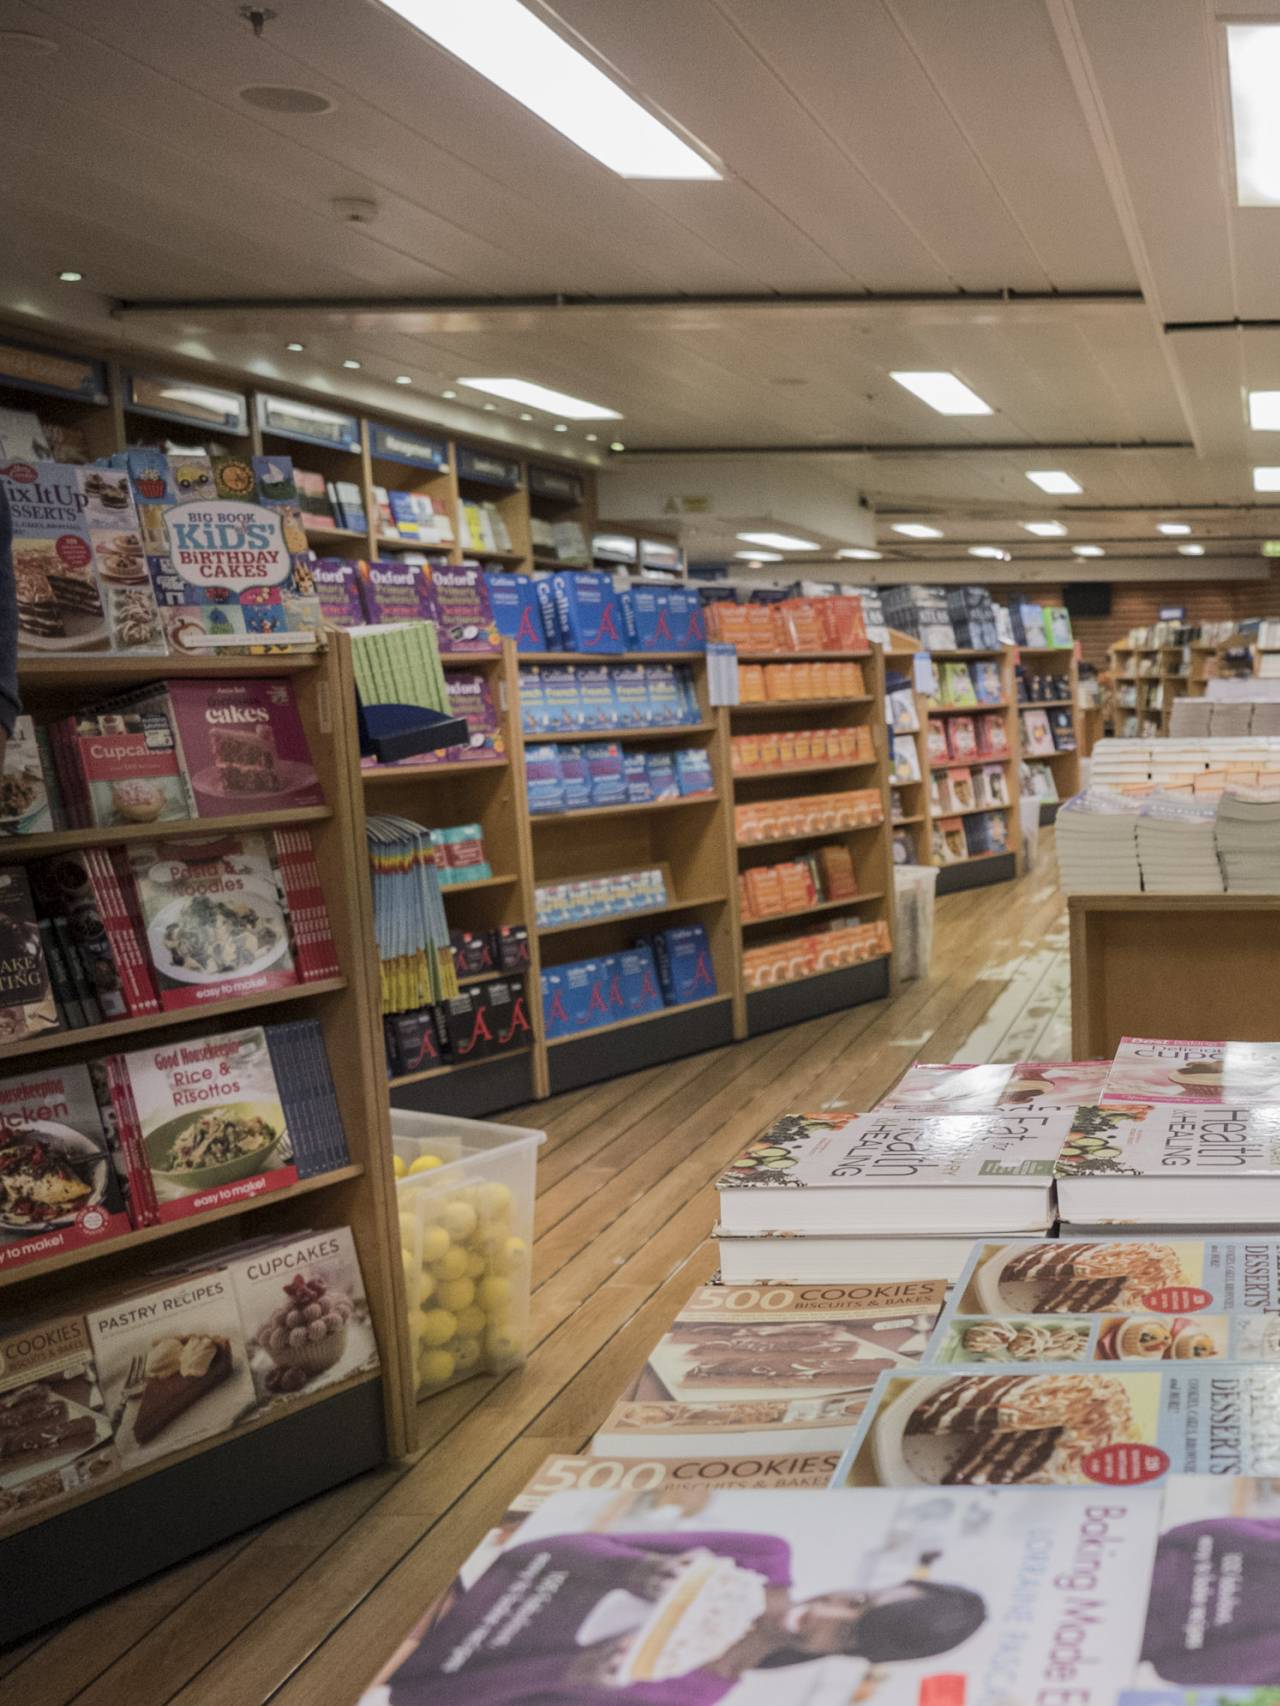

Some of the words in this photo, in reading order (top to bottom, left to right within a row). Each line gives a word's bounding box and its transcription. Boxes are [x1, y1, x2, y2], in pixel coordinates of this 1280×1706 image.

[57, 486, 89, 513] Up
[12, 506, 77, 523] SSERTS
[217, 512, 256, 523] BOOK
[200, 565, 269, 579] CAKES
[369, 570, 415, 586] Oxford
[432, 570, 476, 586] Oxford
[205, 705, 270, 724] cakes
[170, 863, 220, 882] Pasta
[223, 862, 238, 875] &
[172, 877, 244, 896] Noodles
[196, 986, 221, 1000] easy
[221, 982, 233, 995] to
[233, 975, 268, 993] make!
[155, 1051, 180, 1071] Good
[181, 1039, 242, 1064] Housekeeping
[173, 1068, 213, 1087] Rice
[218, 1061, 232, 1077] &
[173, 1080, 240, 1107] Risottos
[831, 1123, 897, 1177] HEALING
[1161, 1115, 1197, 1167] HEALING
[1198, 1109, 1264, 1167] Health
[194, 1191, 217, 1208] easy
[219, 1187, 232, 1201] to
[234, 1177, 266, 1197] make!
[7, 1246, 21, 1259] to
[22, 1234, 64, 1255] make!
[247, 1239, 340, 1281] CUPCAKES
[1243, 1245, 1269, 1309] DESSERTS
[98, 1304, 158, 1333] PASTRY
[164, 1282, 224, 1312] RECIPES
[690, 1287, 796, 1312] 500
[799, 1283, 936, 1301] COOKIES
[794, 1300, 863, 1312] BISCUITS
[867, 1299, 881, 1309] &
[6, 1322, 82, 1361] COOKIES
[1209, 1377, 1242, 1475] DESSERTS
[532, 1459, 667, 1492] 500
[671, 1455, 838, 1480] COOKIES
[1053, 1504, 1130, 1593] Baking
[1044, 1596, 1109, 1682] Made
